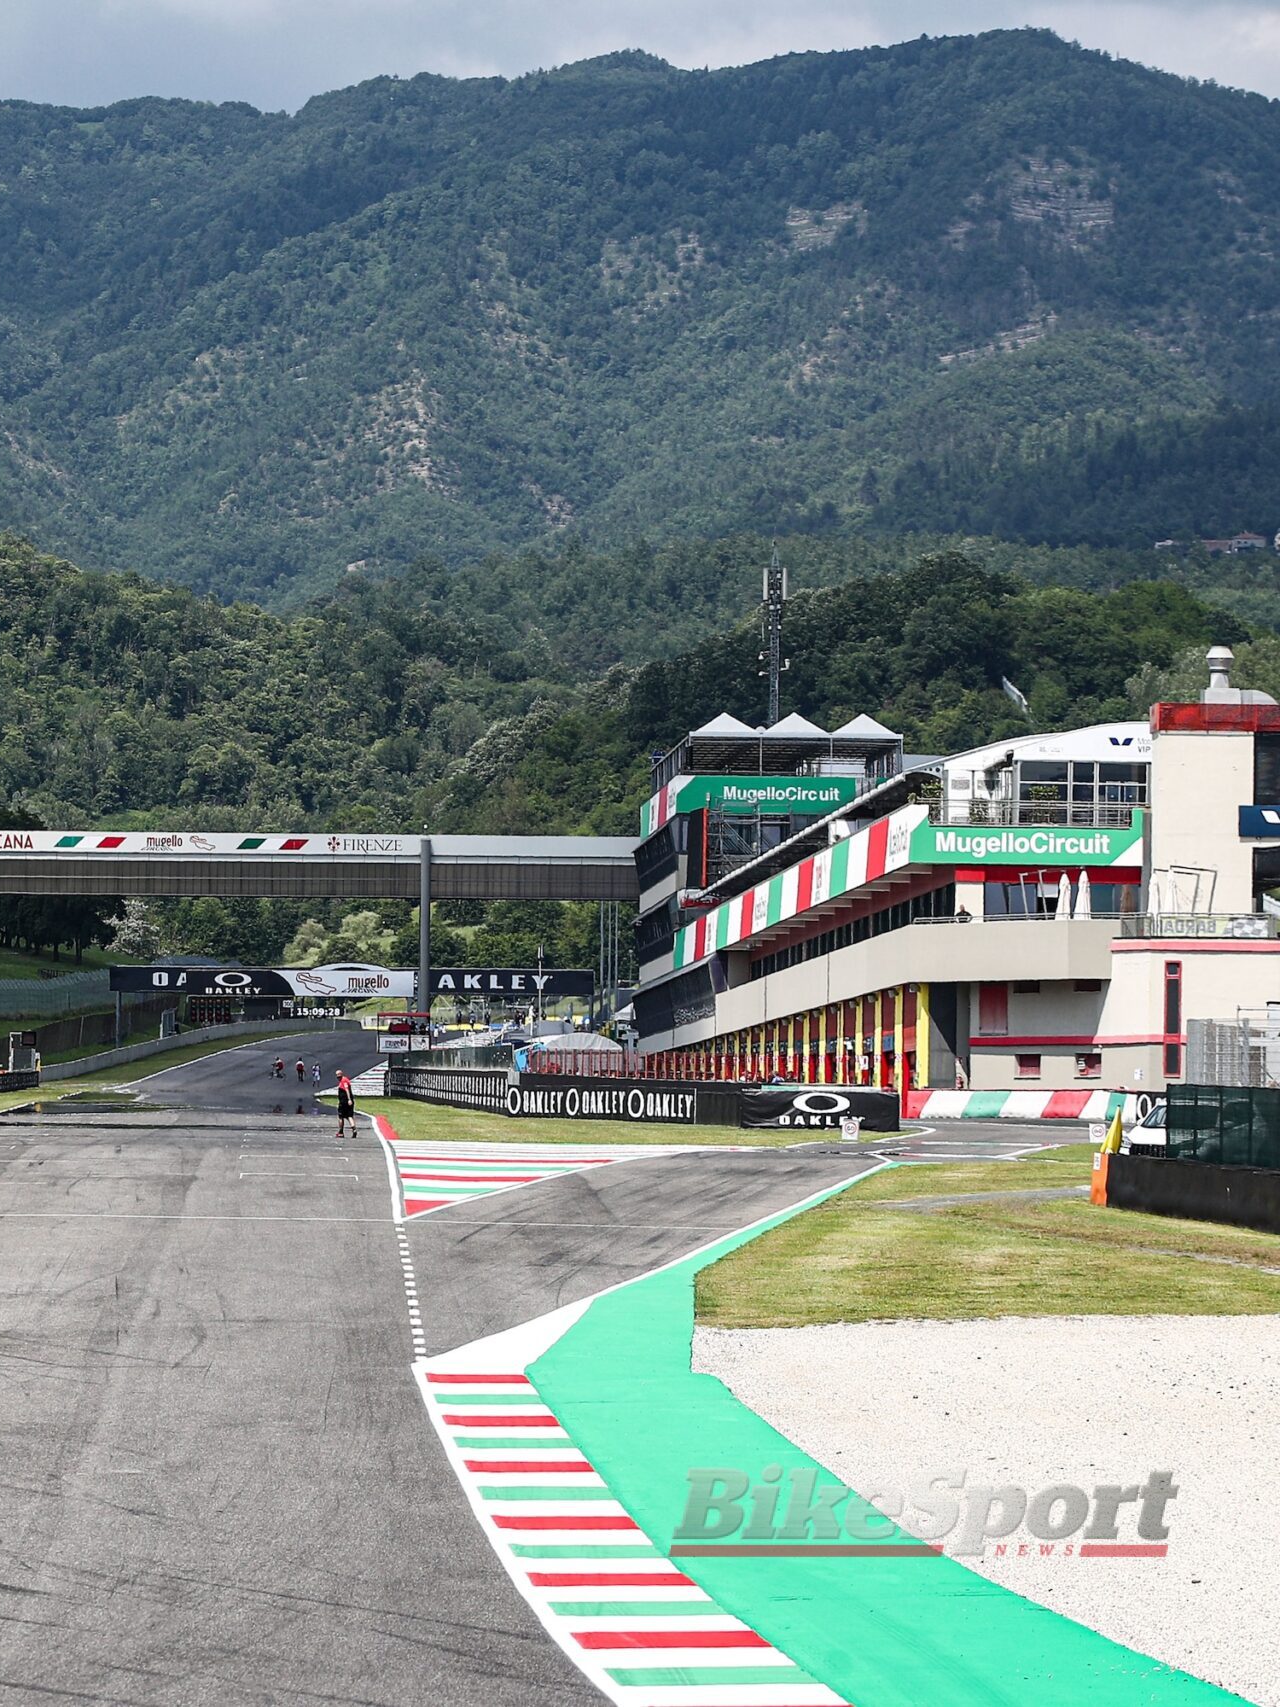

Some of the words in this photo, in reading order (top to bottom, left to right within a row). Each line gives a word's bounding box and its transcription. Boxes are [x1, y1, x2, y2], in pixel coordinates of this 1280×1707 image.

[723, 786, 841, 803] MugelloCircuit
[147, 834, 183, 848] mugello
[343, 838, 403, 853] FIRENZE
[935, 831, 1110, 858] MugelloCircuit
[348, 974, 389, 989] mugello
[296, 1007, 341, 1016] 15:09:28
[523, 1090, 563, 1114] OAKLEY
[582, 1090, 626, 1114] OAKLEY
[646, 1093, 694, 1118] OAKLEY
